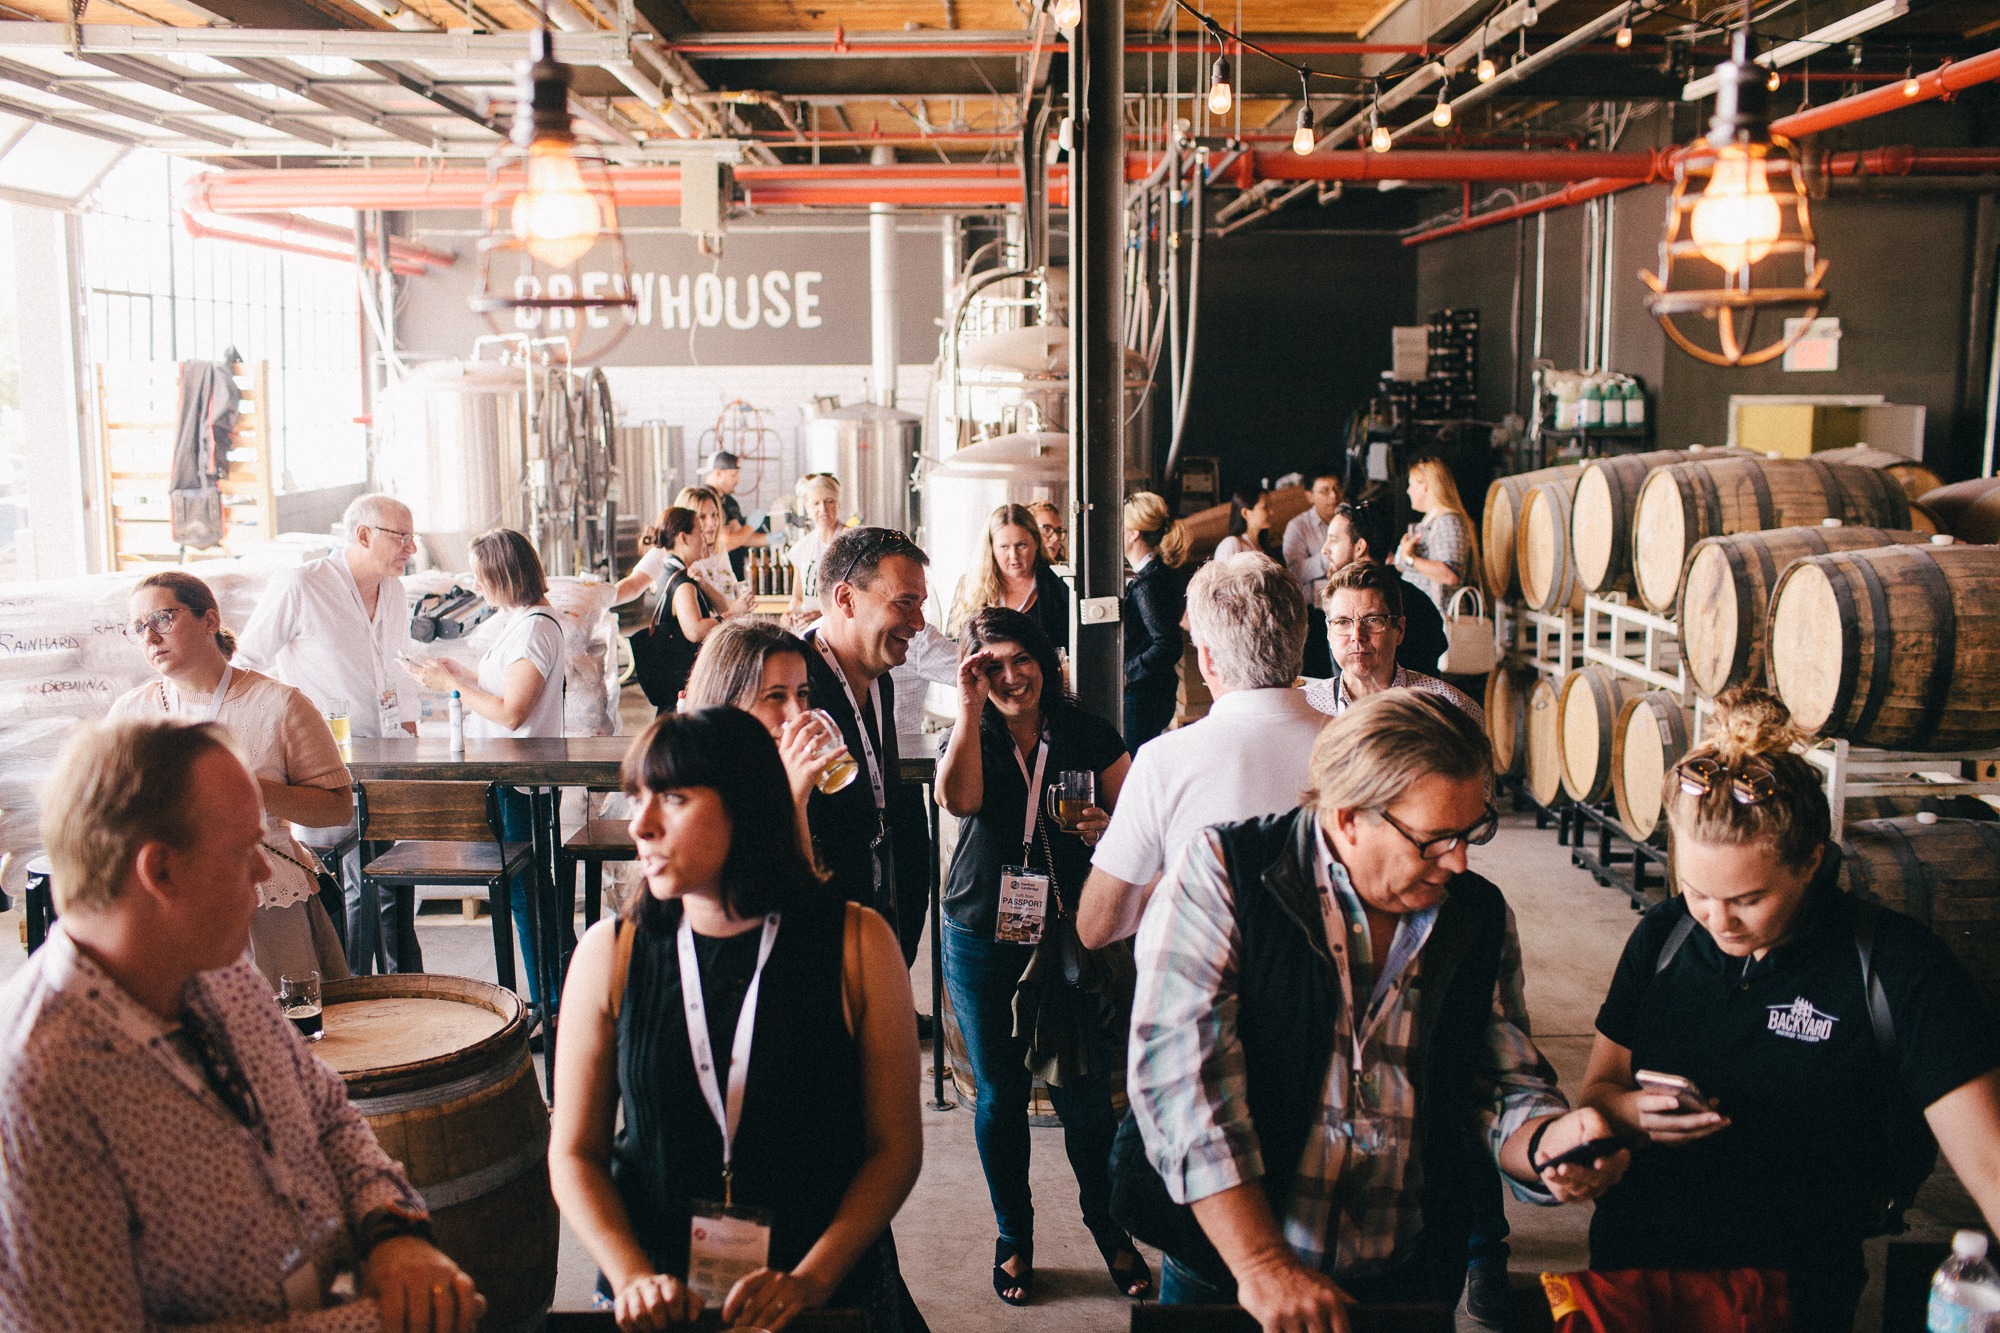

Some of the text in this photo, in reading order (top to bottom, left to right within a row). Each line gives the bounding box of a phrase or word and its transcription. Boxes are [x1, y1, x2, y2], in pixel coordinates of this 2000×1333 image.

[513, 270, 823, 331] BREWHOUSE
[1002, 897, 1043, 908] PASSPORT
[1767, 1010, 1833, 1040] BACKYARD
